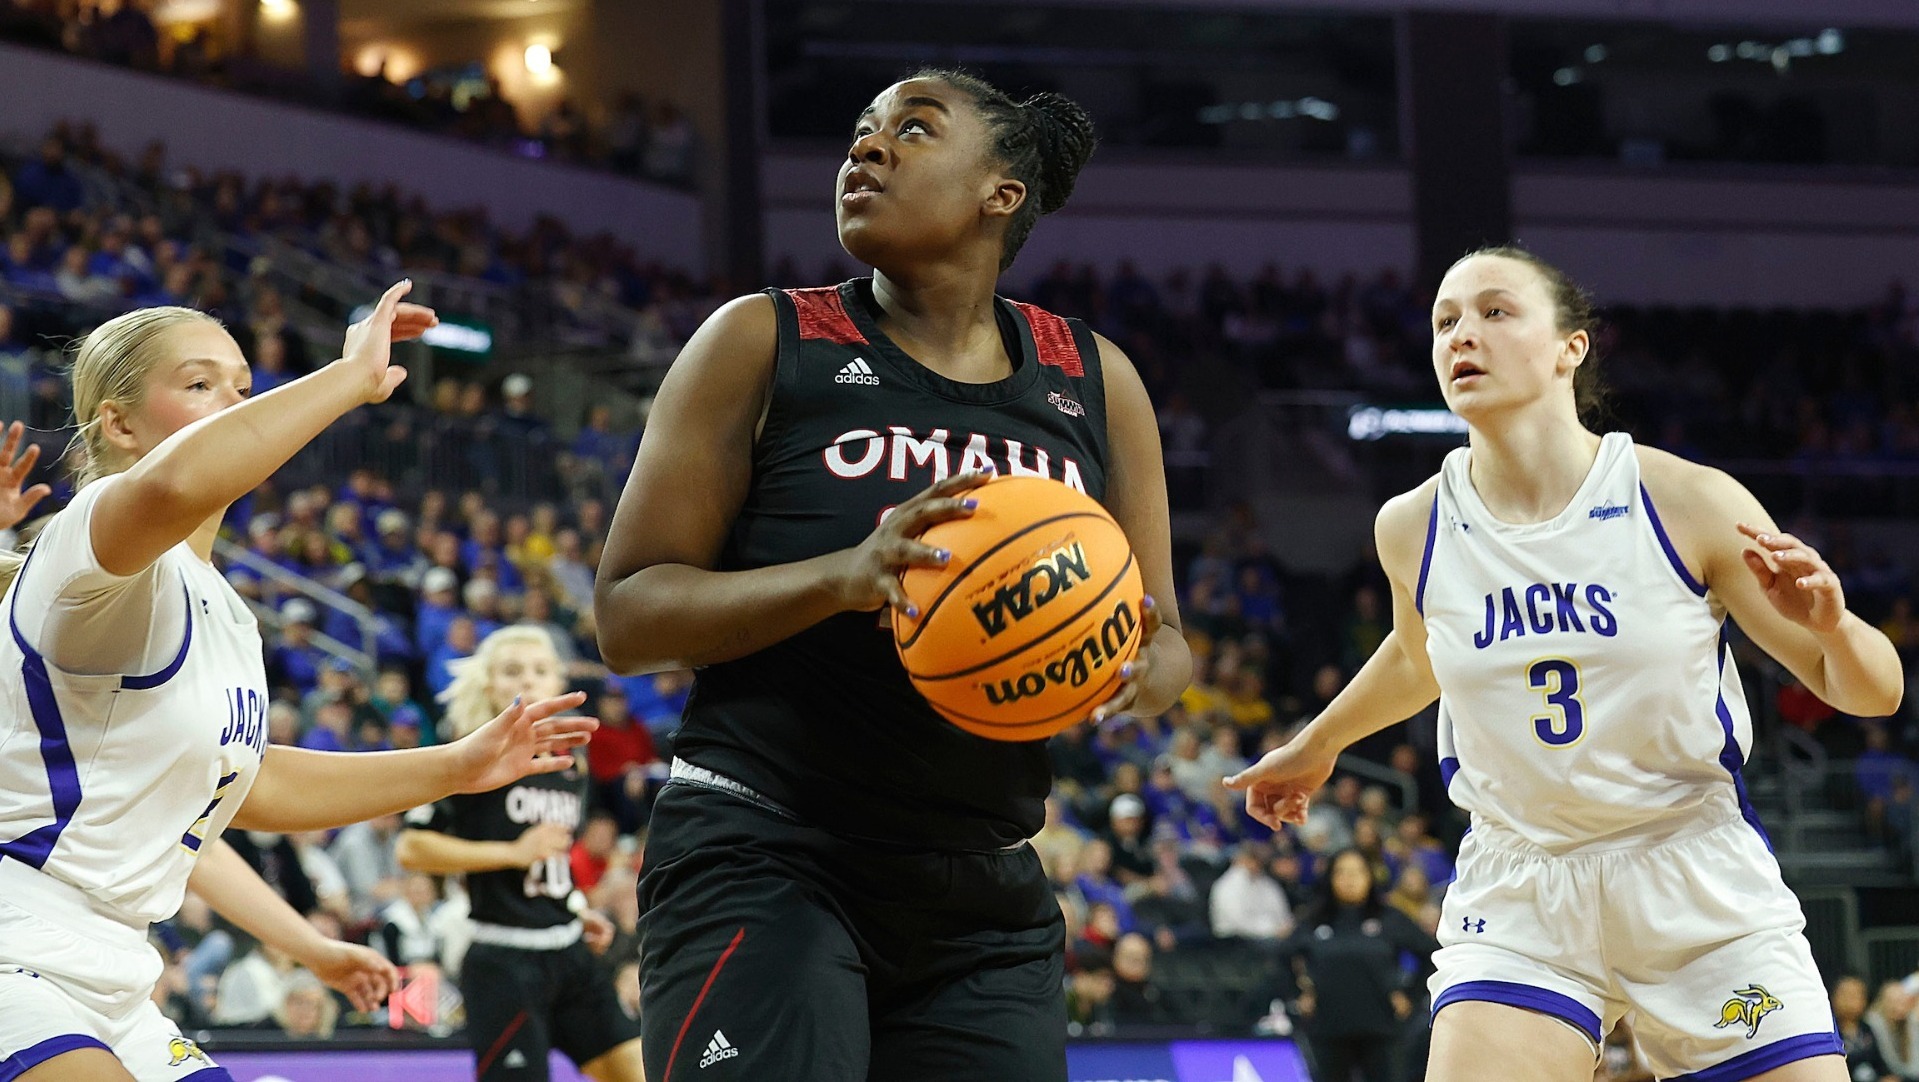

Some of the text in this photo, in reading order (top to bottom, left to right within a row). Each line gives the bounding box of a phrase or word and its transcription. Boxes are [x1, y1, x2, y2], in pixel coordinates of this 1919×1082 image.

[834, 373, 880, 386] adidas
[972, 540, 1091, 639] NCAA
[1474, 583, 1618, 650] JACKS
[983, 599, 1137, 706] Wilson
[1525, 655, 1588, 751] 3
[700, 1047, 739, 1069] adidas
